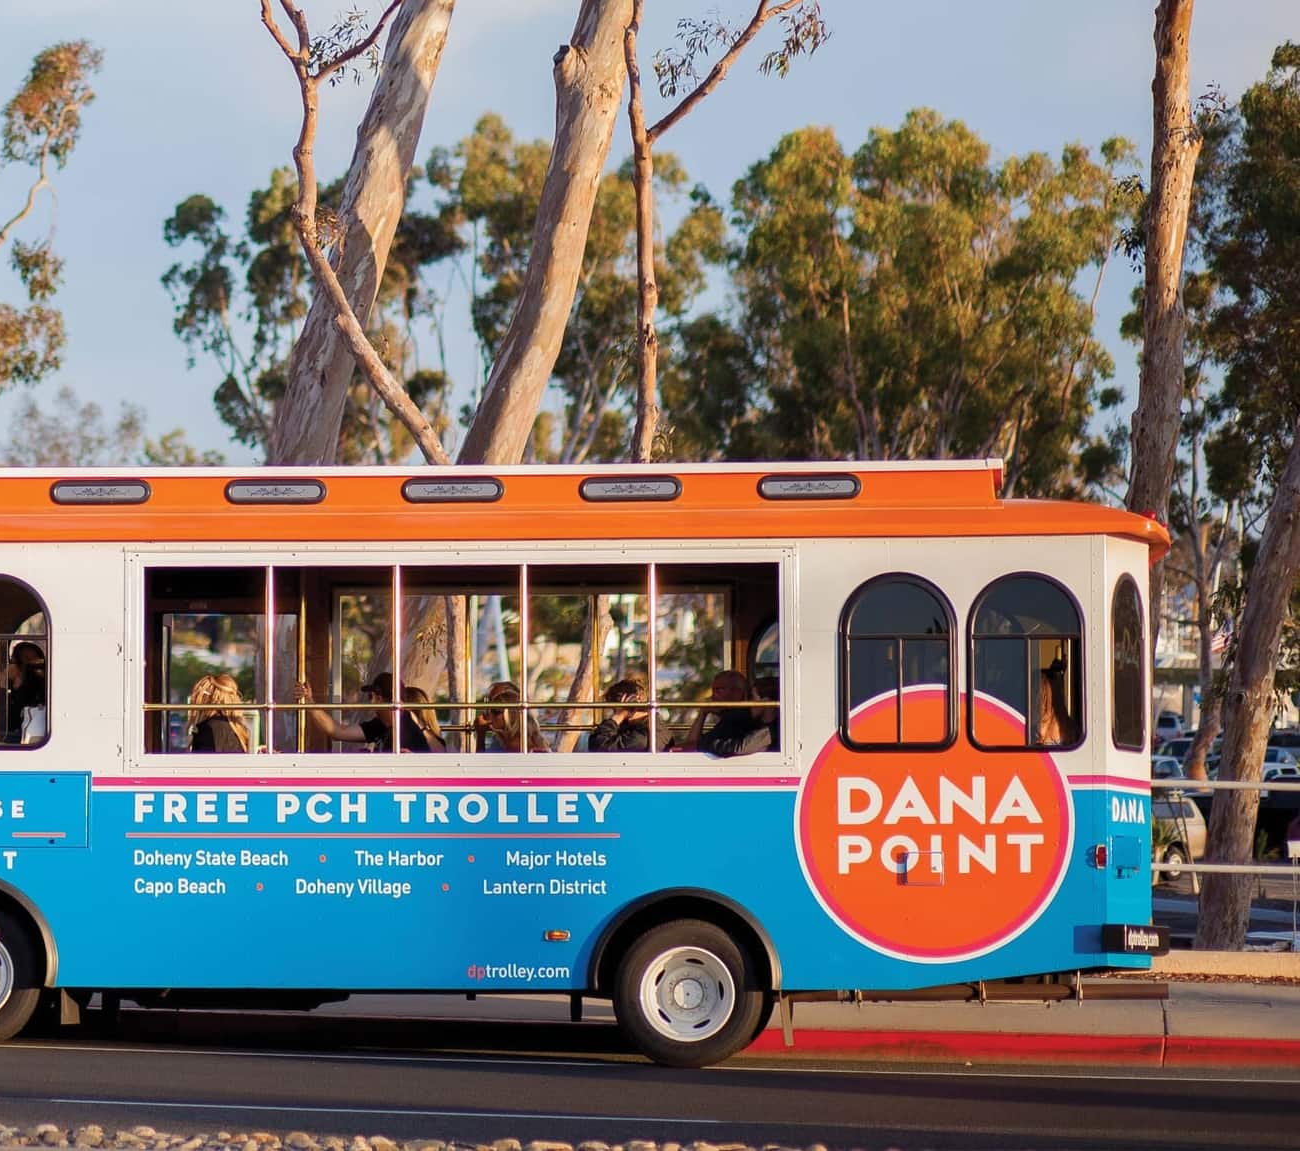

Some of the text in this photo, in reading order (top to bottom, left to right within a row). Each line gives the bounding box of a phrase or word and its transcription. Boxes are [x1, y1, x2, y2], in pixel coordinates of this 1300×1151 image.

[133, 792, 614, 824] FREE PCH TROLLEY
[837, 775, 1043, 825] DANA
[1111, 796, 1146, 825] DANA
[133, 850, 289, 869] Doheny State Beach
[354, 850, 444, 866] The Harbor
[506, 850, 607, 869] Major Hotels
[837, 833, 1044, 875] POINT
[133, 878, 226, 897] Capo Beach
[295, 879, 411, 898] Doheny Village
[483, 879, 607, 895] Lantern District
[466, 963, 570, 982] dptrolley.com
